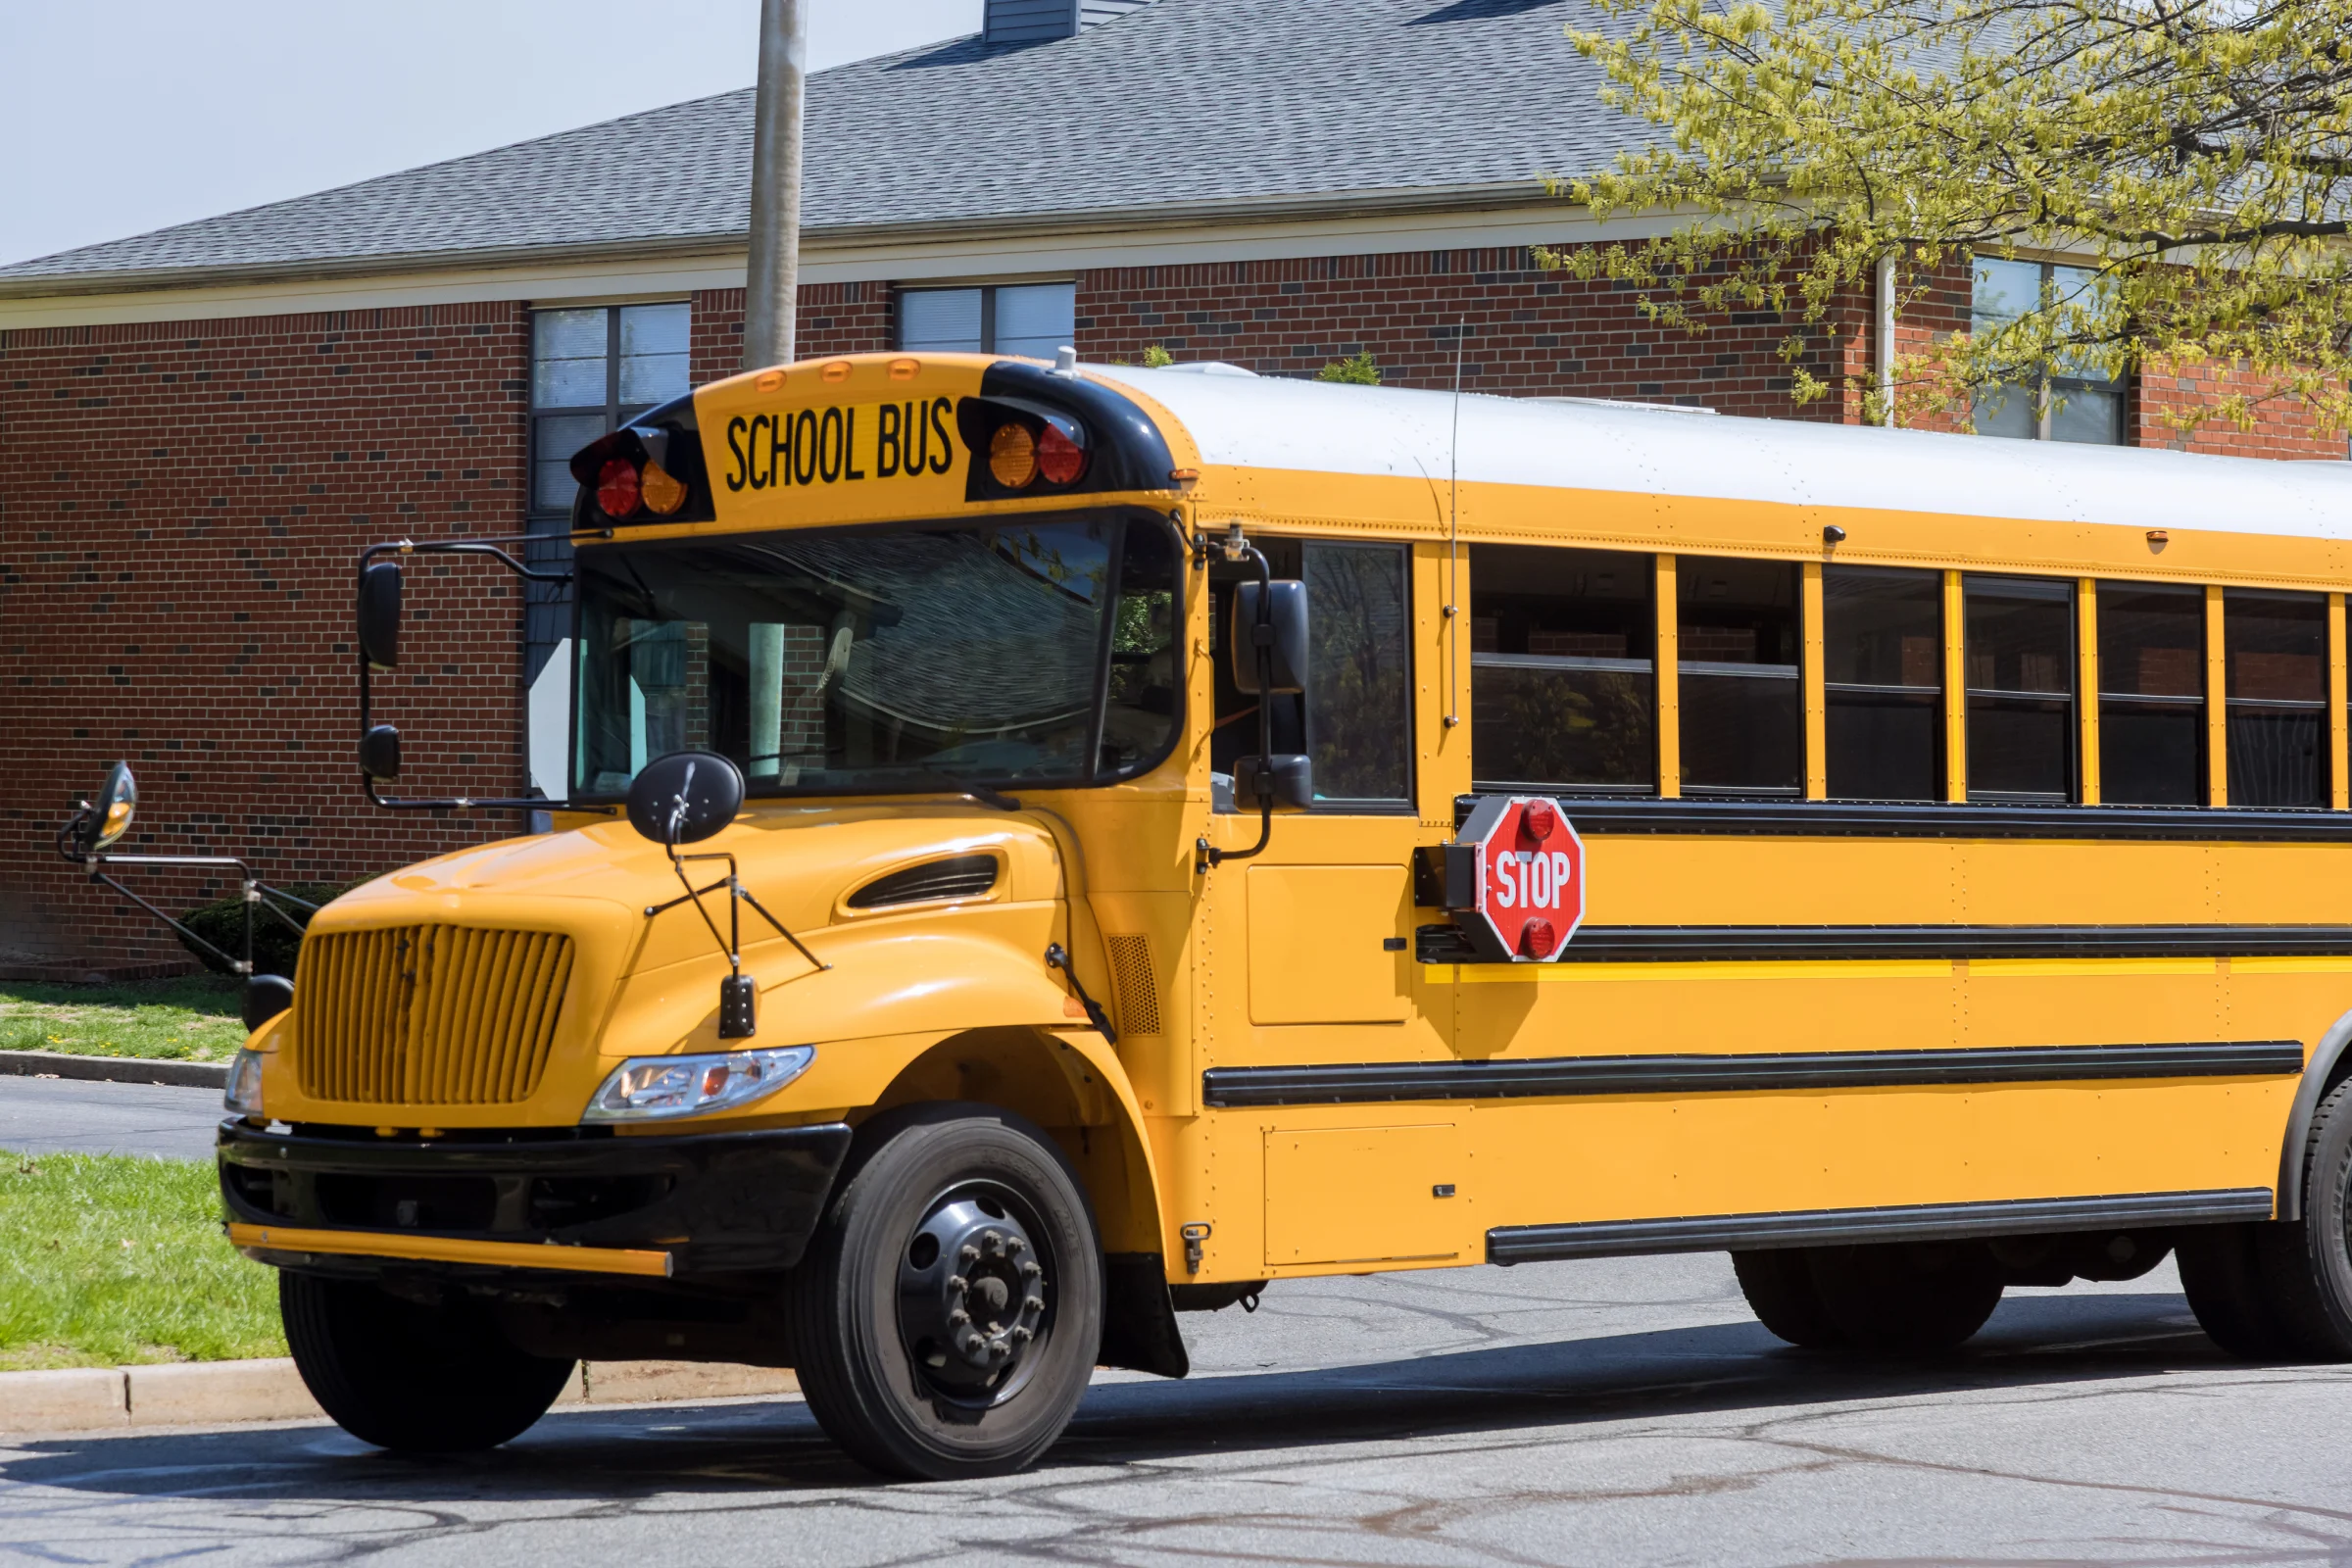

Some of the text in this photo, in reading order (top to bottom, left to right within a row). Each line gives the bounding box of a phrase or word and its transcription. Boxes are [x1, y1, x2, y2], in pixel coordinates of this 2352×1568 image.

[726, 397, 953, 492] SCHOOL BUS
[1496, 851, 1570, 908] STOP
